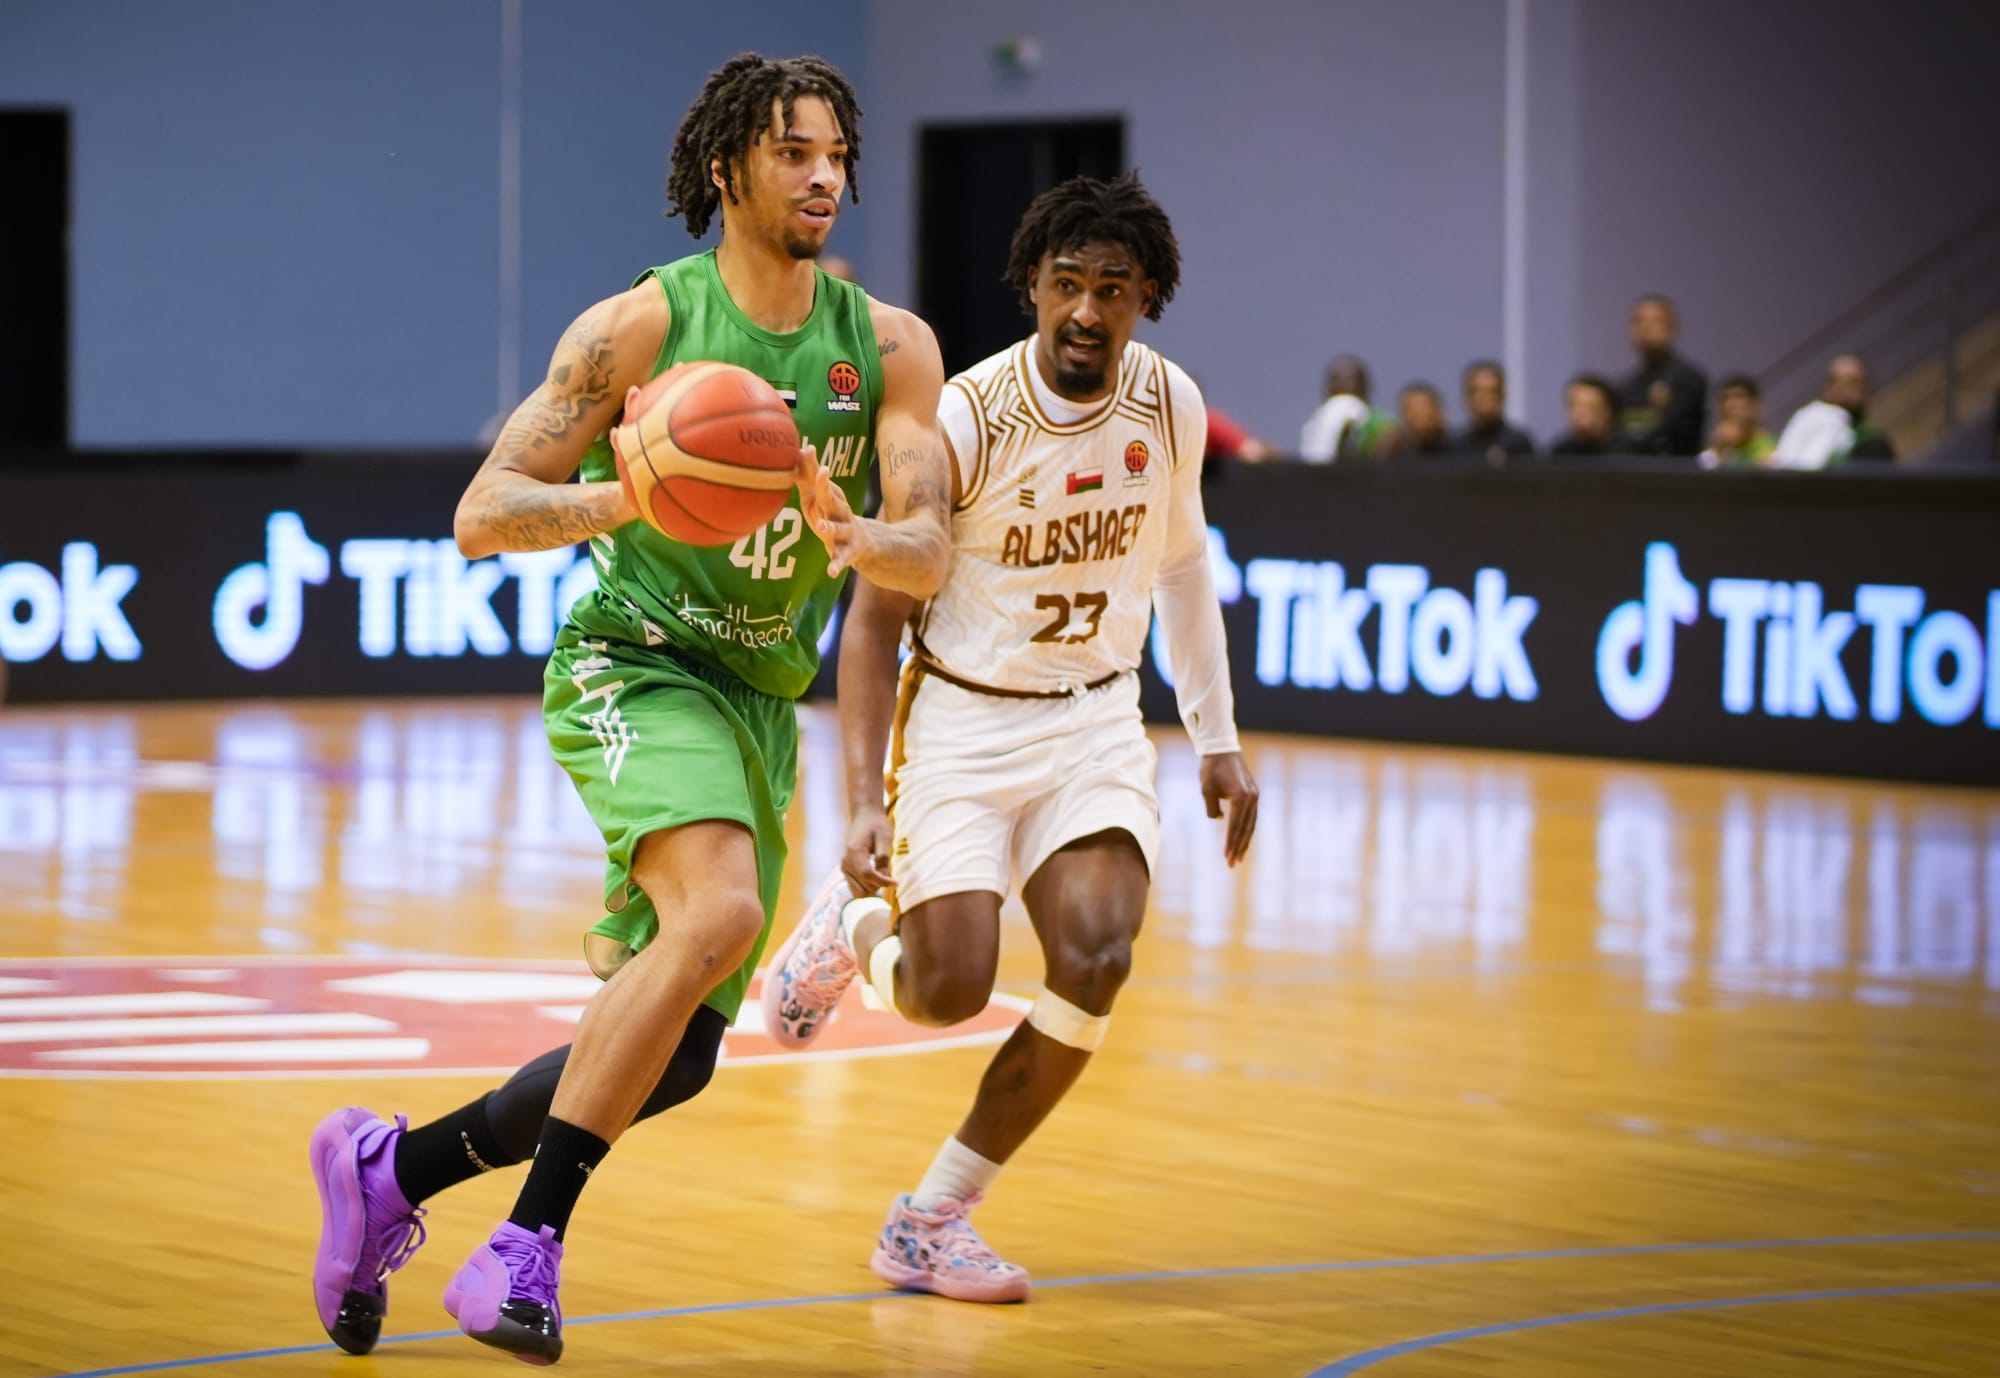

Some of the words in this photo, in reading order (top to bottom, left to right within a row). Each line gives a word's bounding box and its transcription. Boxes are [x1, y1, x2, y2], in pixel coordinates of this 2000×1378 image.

[728, 507, 803, 580] 42
[340, 538, 602, 657] TikT
[1029, 590, 1109, 645] 23
[1244, 557, 1542, 703] TikTok
